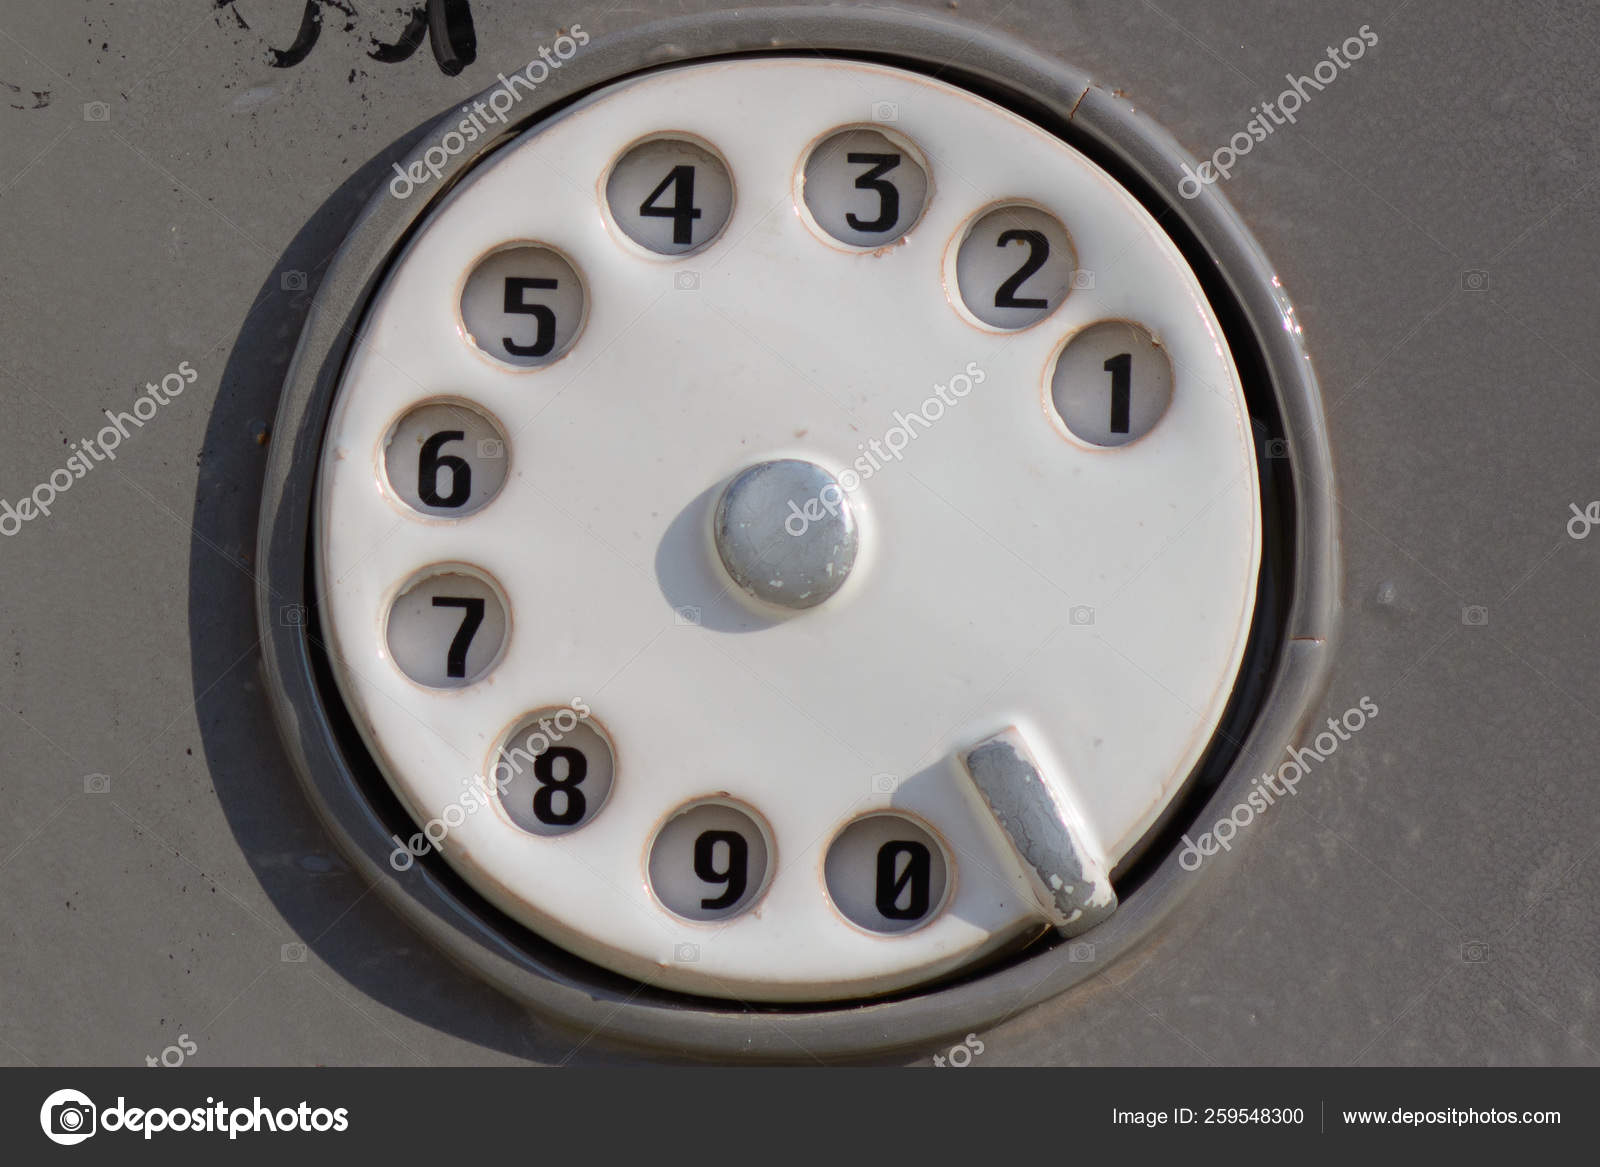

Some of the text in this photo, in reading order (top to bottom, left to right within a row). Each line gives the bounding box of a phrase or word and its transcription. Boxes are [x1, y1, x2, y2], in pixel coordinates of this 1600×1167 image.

[639, 165, 702, 245] 4
[846, 152, 901, 233] 3
[994, 229, 1050, 309] 2
[502, 276, 559, 358] 5
[1103, 353, 1132, 434] 1
[418, 430, 472, 508] 6
[431, 596, 485, 678] 7
[533, 746, 588, 827] 8
[693, 829, 749, 911] 9
[875, 839, 932, 922] 0
